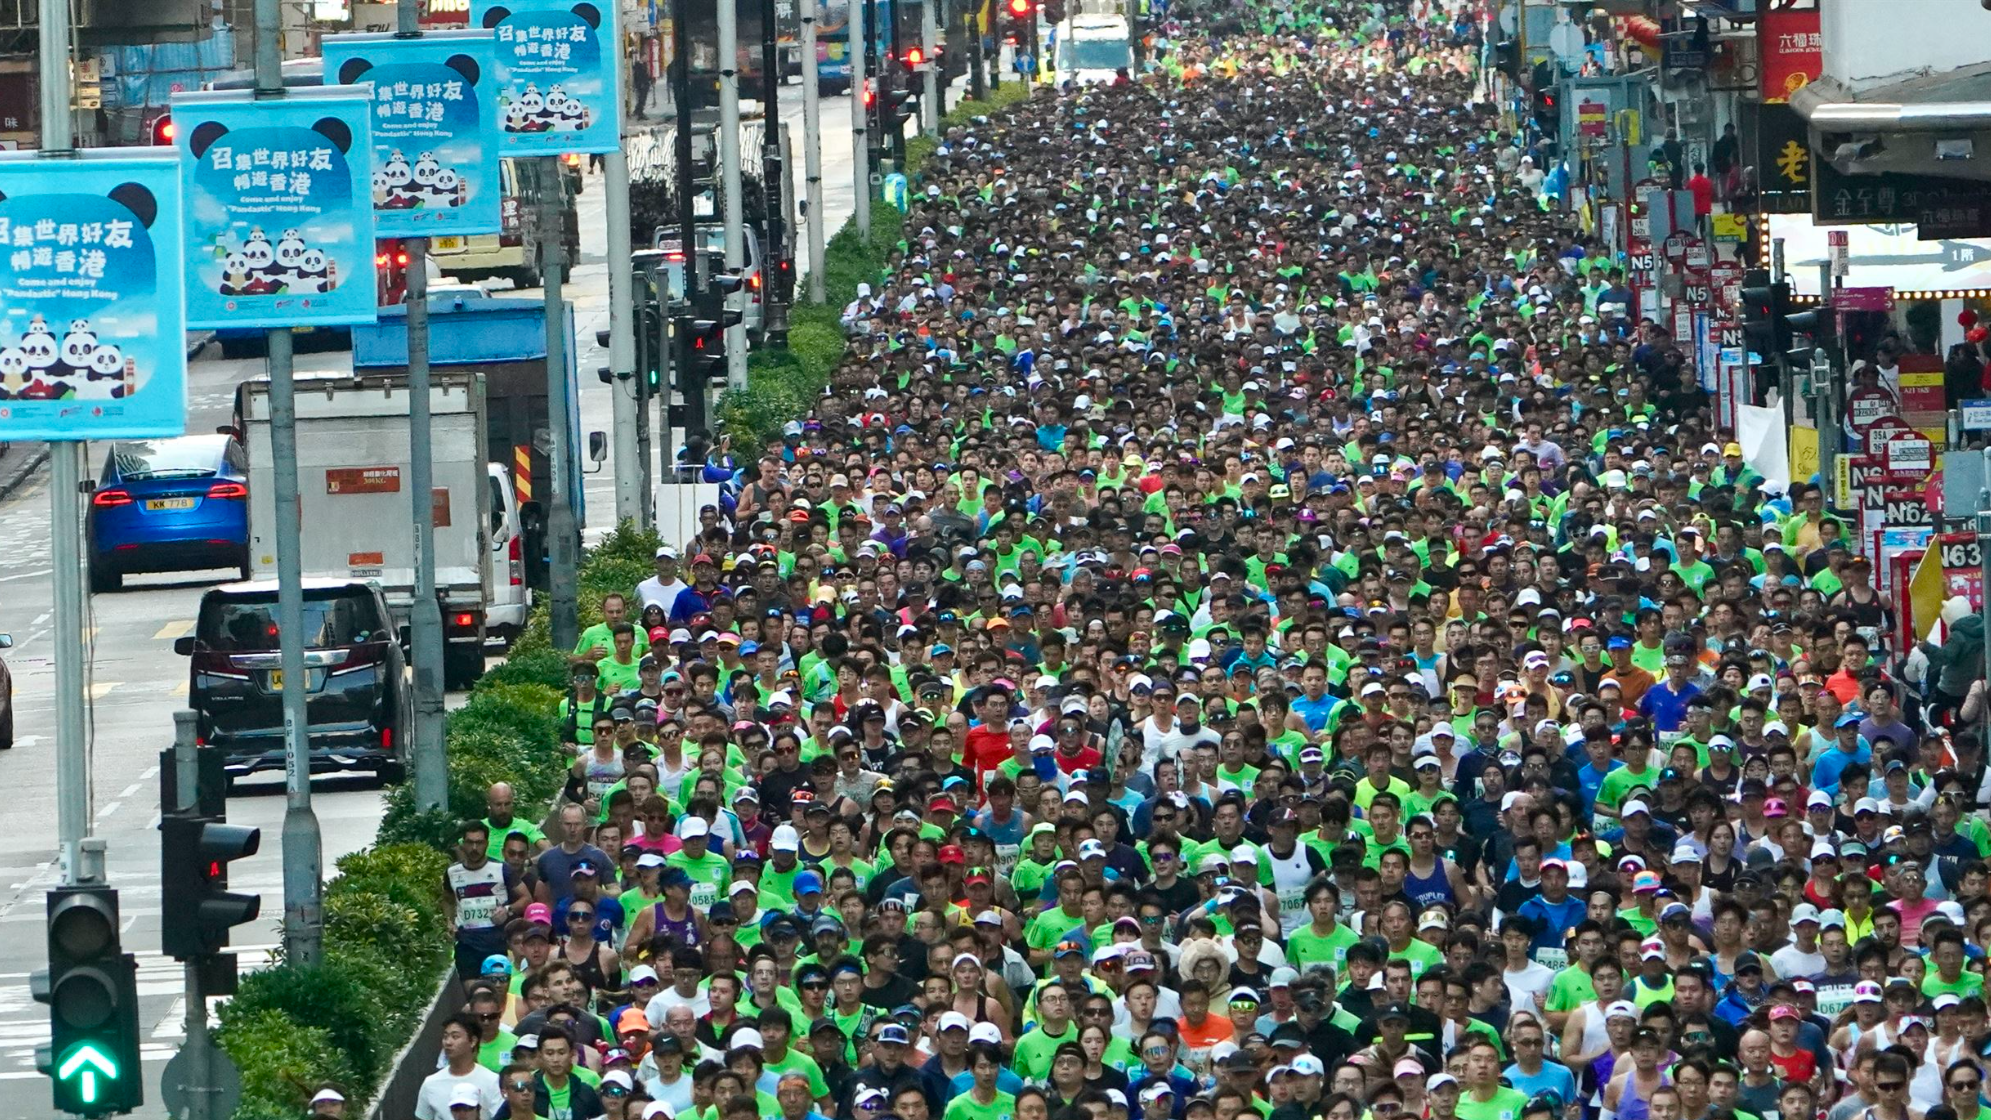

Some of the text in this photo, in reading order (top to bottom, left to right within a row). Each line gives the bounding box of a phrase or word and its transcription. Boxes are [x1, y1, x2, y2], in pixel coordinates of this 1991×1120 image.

[498, 24, 587, 43] 召集世界好友
[1779, 32, 1822, 48] 六福珠
[514, 42, 571, 60] 暢遊香港
[369, 80, 463, 101] 集世界好友
[377, 101, 444, 122] 暢遊香港
[212, 147, 333, 170] 召集世界好友
[1776, 140, 1808, 183] 老
[233, 171, 312, 195] 暢遊香港
[264, 195, 279, 203] and
[279, 195, 304, 204] enjoy
[276, 205, 299, 214] Hong
[300, 205, 321, 214] Kong
[10, 247, 107, 278] 暢遊香港
[1631, 256, 1654, 271] N5
[18, 277, 96, 288] Come and enjoy
[62, 289, 89, 300] Hong
[90, 290, 119, 301] Kong
[1686, 286, 1708, 301] N5
[1873, 431, 1887, 440] 35A
[153, 500, 165, 509] KK
[464, 908, 495, 920] D732
